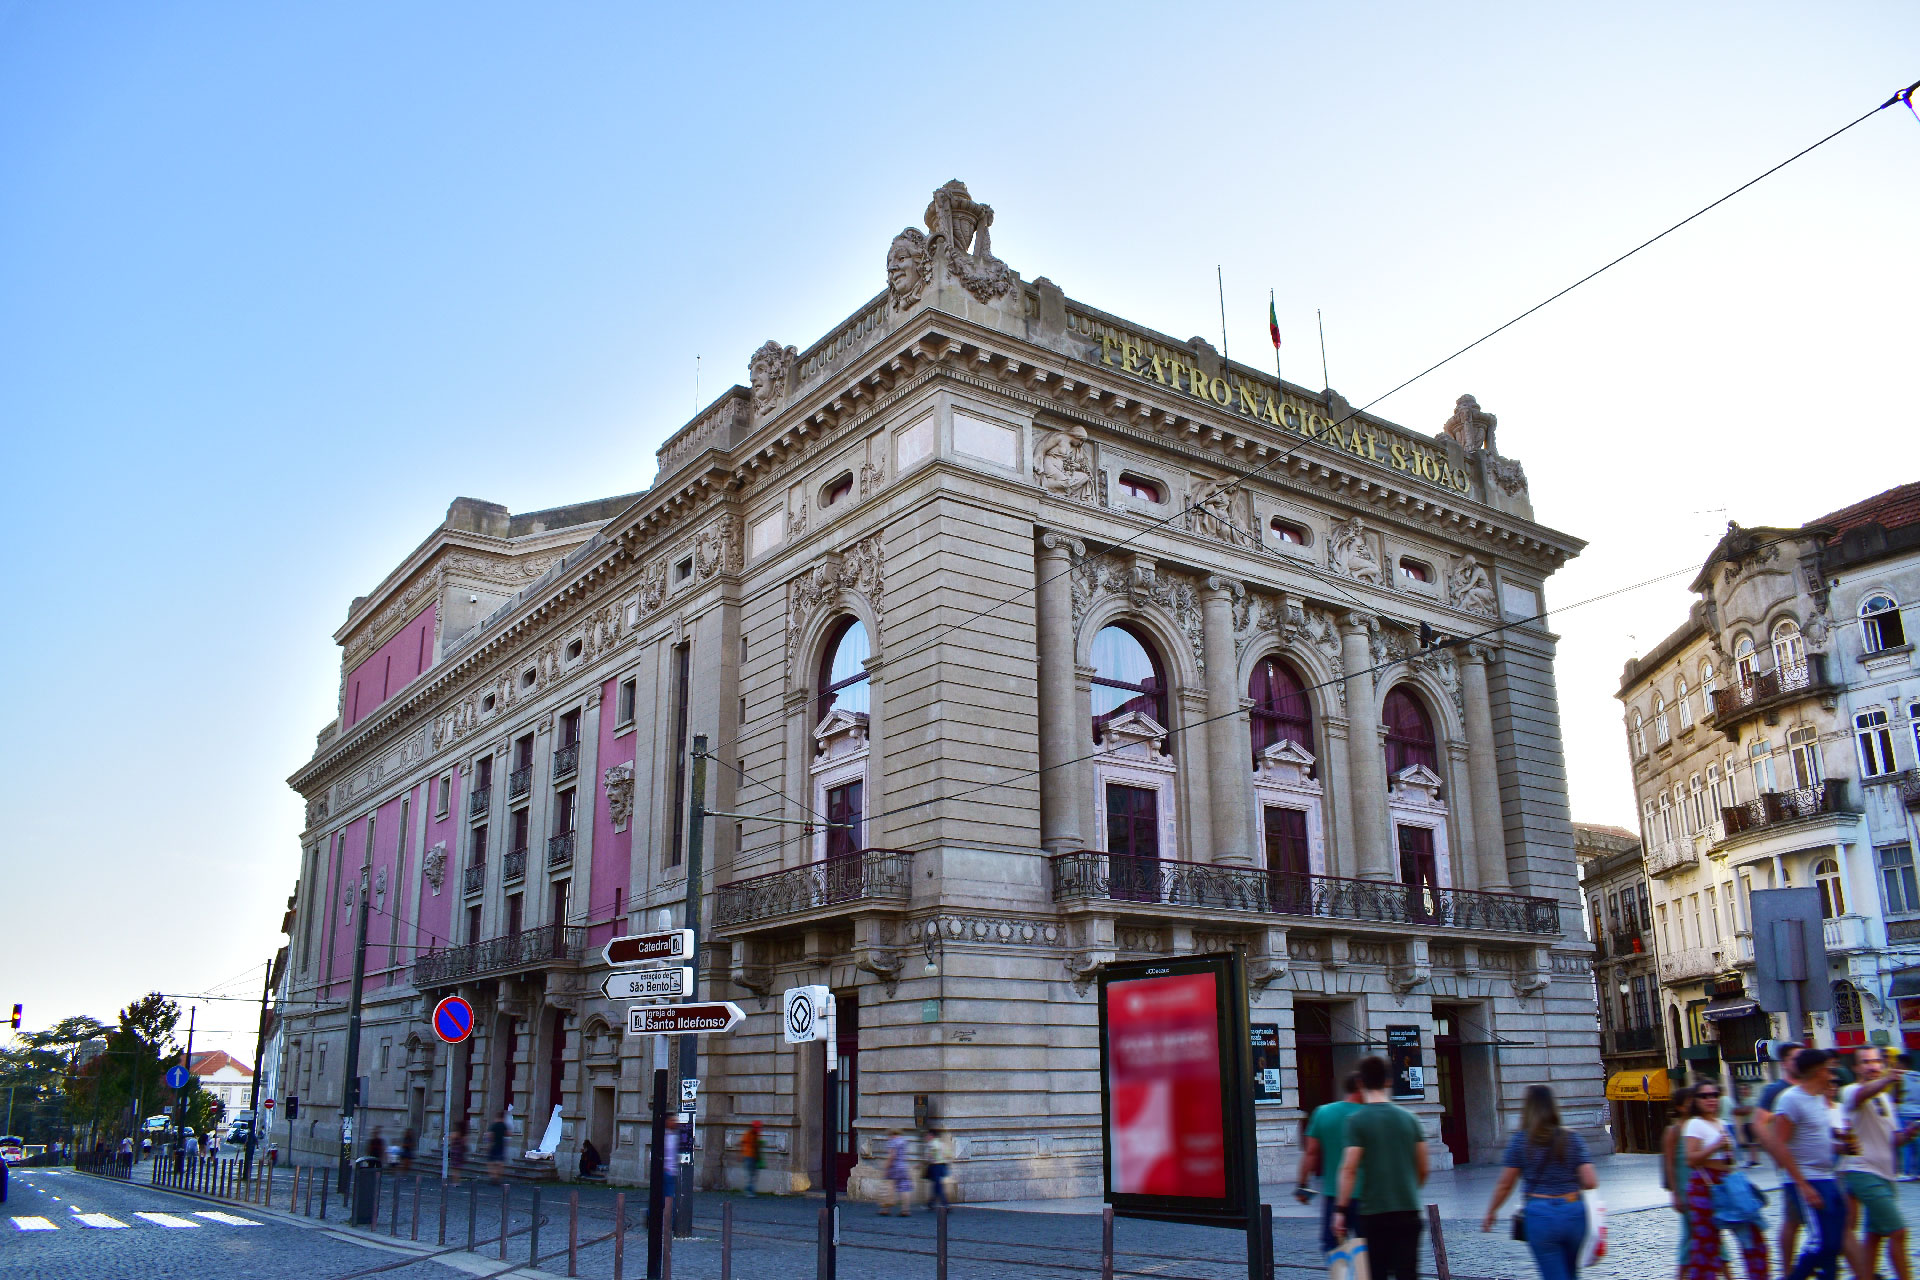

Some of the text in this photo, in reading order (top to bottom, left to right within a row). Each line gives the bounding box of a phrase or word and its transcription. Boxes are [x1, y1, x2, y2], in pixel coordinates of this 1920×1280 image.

[1100, 336, 1232, 406] TEATRO
[1239, 385, 1385, 463] NACIONAL
[638, 939, 671, 953] Catedral
[629, 981, 670, 993] São Bento
[646, 1009, 676, 1018] Igreja de
[646, 1017, 725, 1030] Santo Ildefonso
